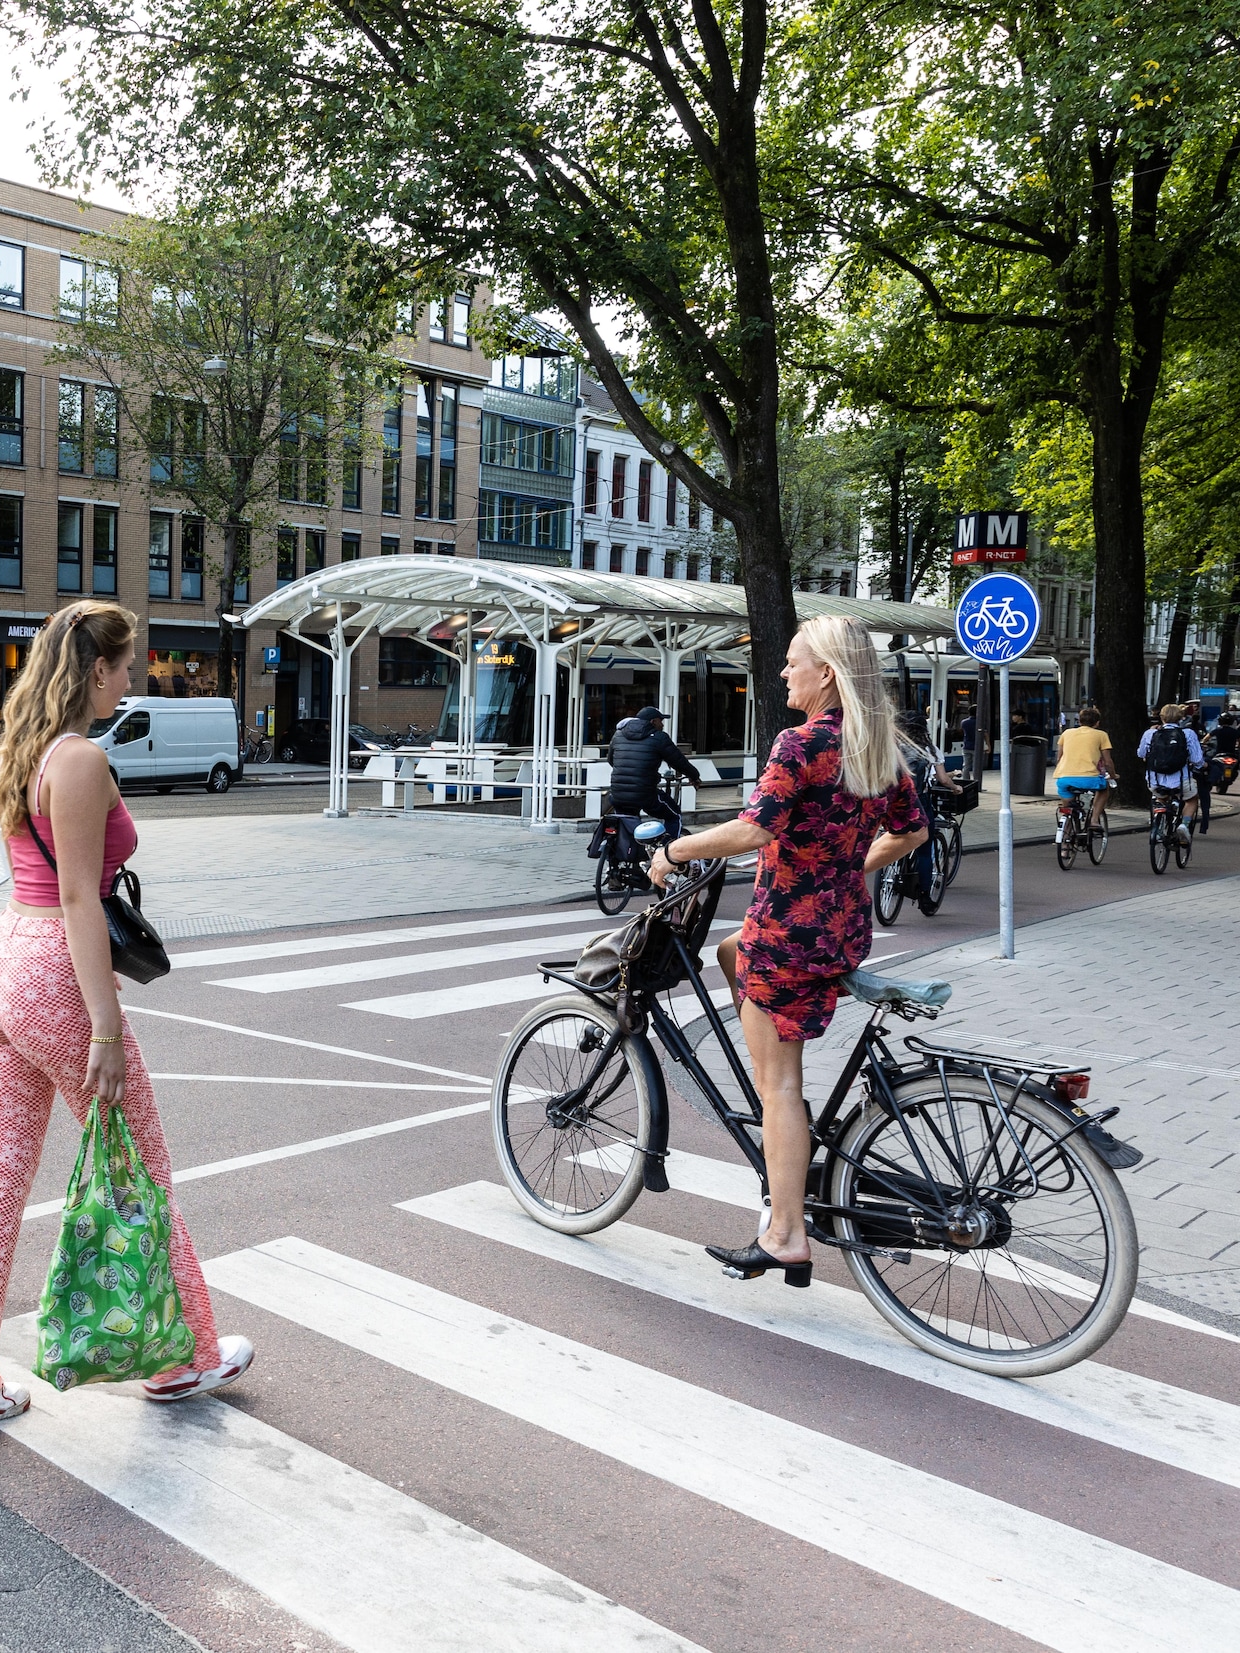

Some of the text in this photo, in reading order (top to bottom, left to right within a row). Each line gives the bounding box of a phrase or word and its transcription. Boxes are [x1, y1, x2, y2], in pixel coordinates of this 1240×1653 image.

[958, 517, 975, 548] M
[987, 515, 1019, 545] M
[8, 625, 43, 637] AMERICA
[268, 649, 276, 661] P
[491, 644, 498, 654] 19
